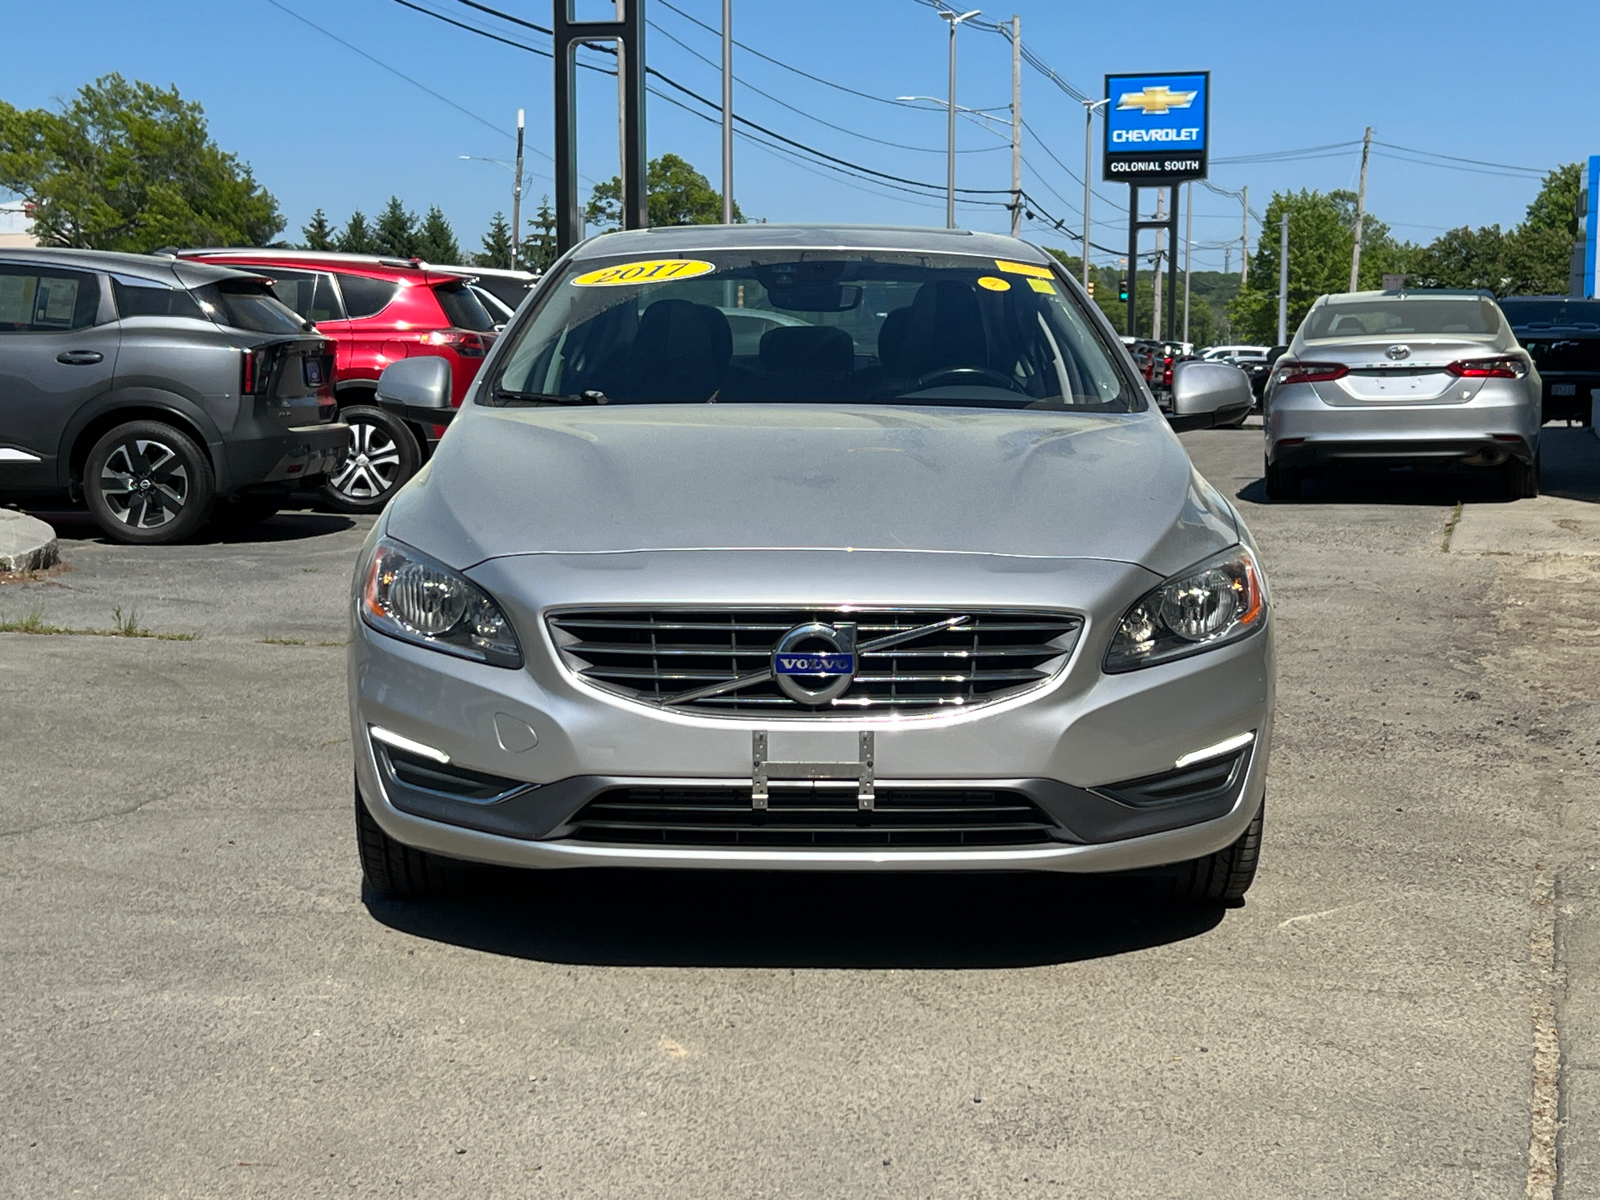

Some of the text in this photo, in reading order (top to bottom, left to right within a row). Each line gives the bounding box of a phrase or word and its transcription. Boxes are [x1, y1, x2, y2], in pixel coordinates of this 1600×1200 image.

[1112, 128, 1199, 143] CHEVROLET
[1111, 160, 1199, 172] COLONIAL SOUTH
[591, 262, 688, 284] 2017
[780, 658, 849, 670] VOLVO
